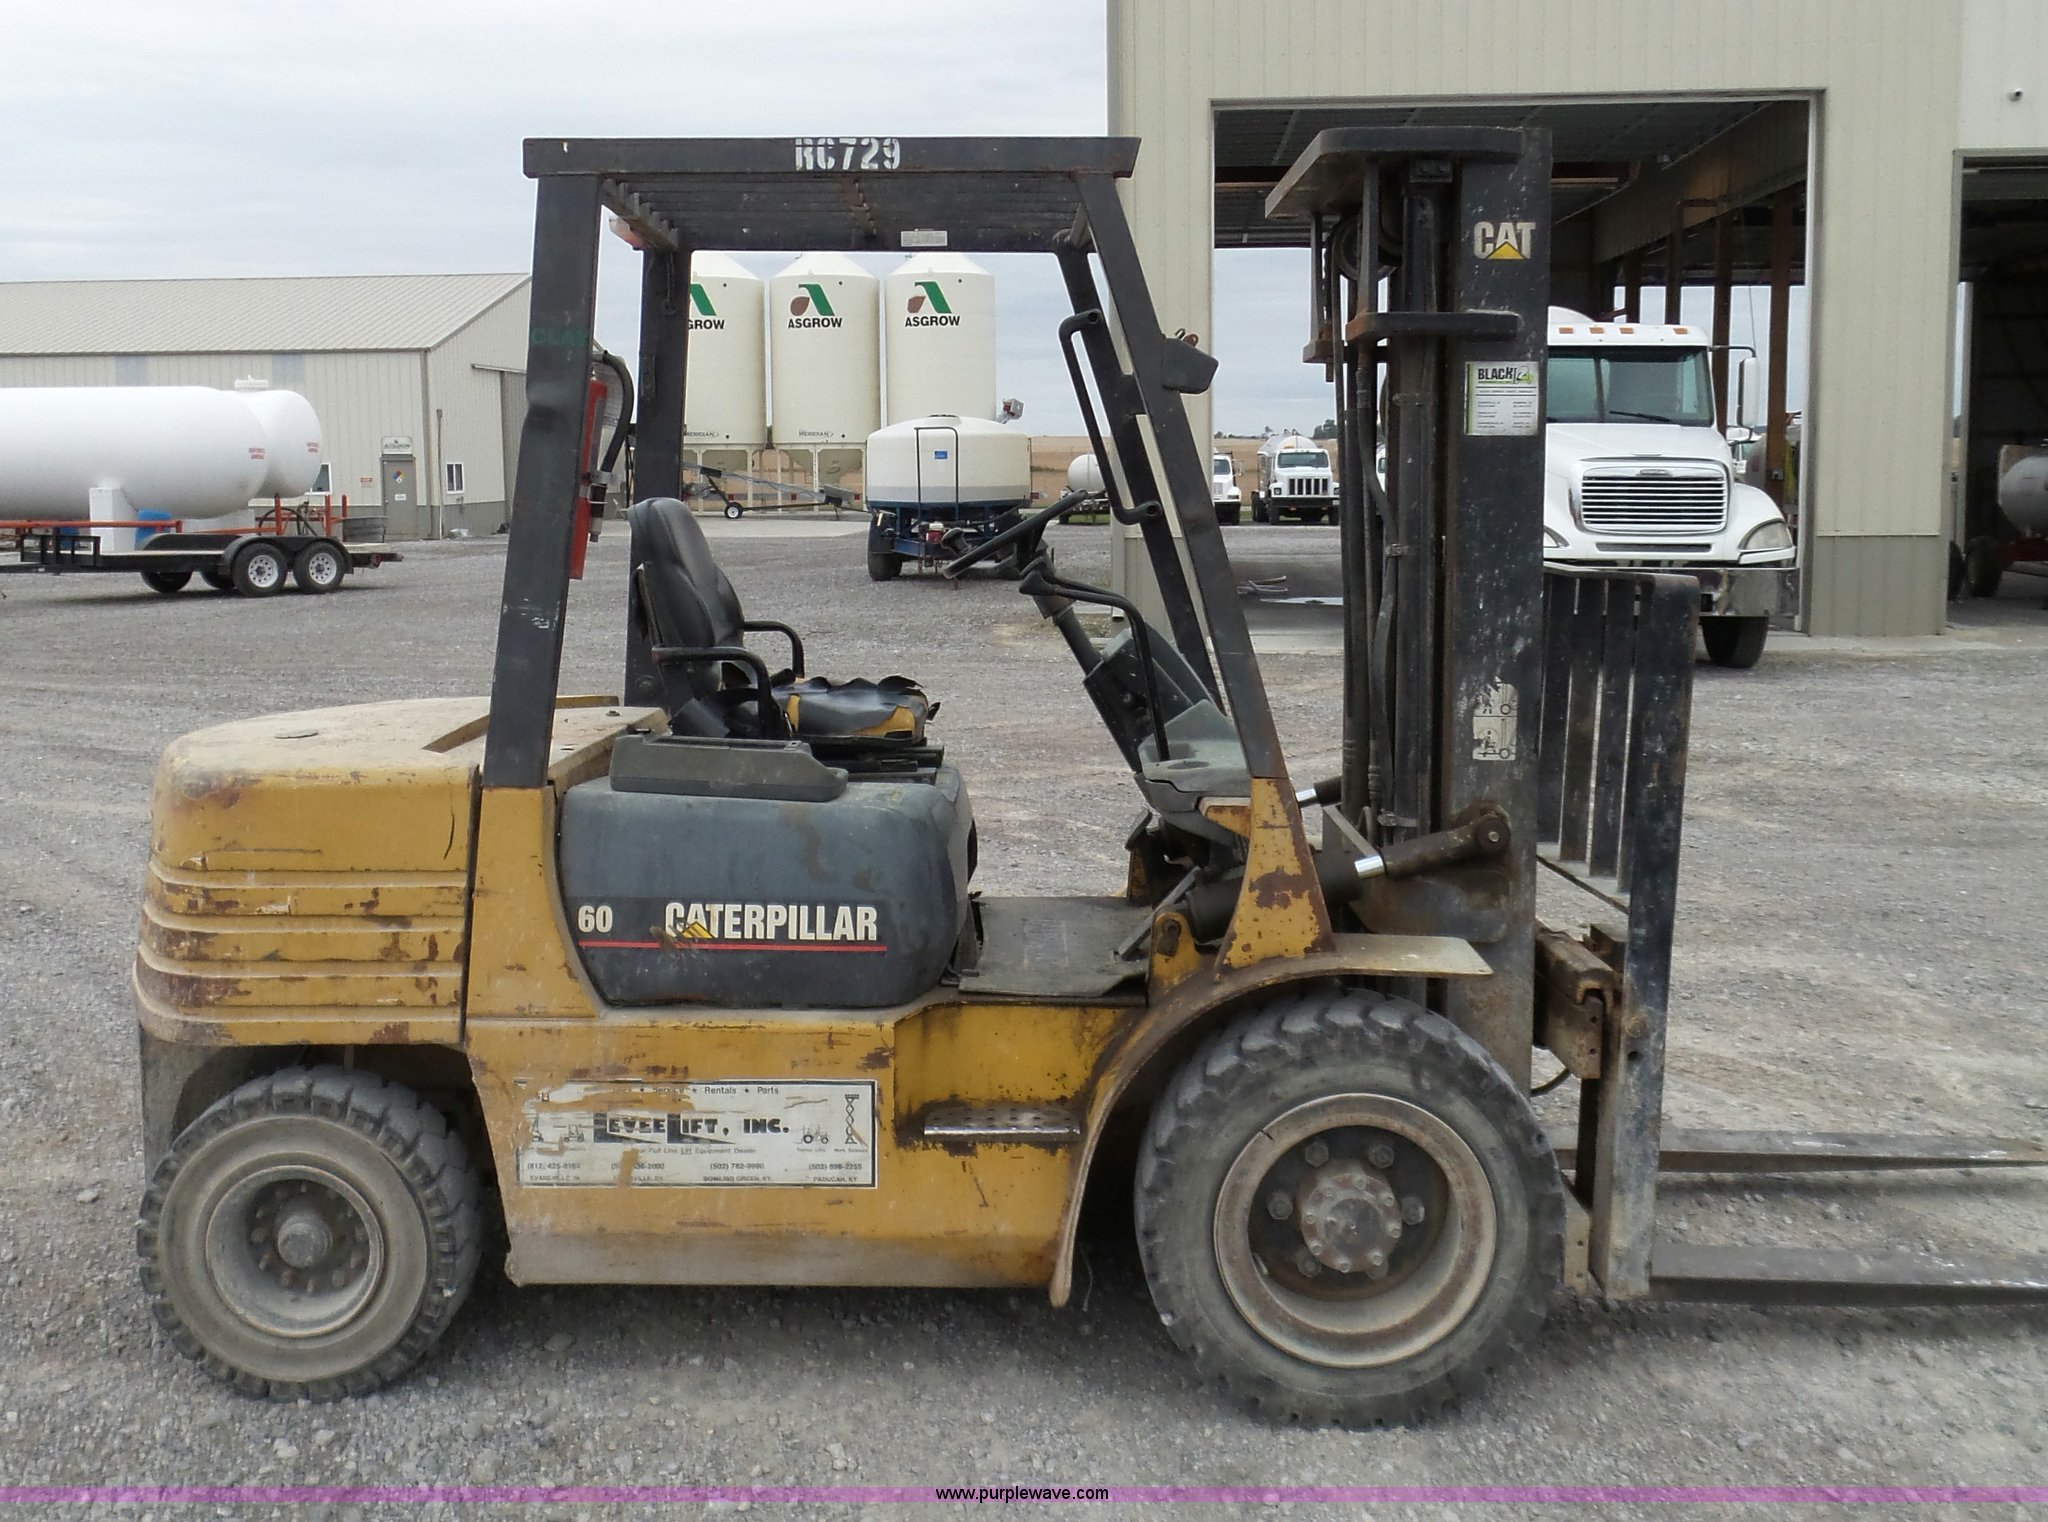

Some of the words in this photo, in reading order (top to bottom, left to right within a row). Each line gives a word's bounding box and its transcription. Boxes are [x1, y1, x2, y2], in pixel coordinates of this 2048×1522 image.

[1473, 221, 1537, 260] CAT
[787, 317, 843, 329] ASGROW
[904, 315, 961, 328] ASGROW
[1477, 366, 1514, 380] BLACK
[577, 905, 613, 933] 60
[665, 902, 878, 941] CATERPILLAR
[704, 1086, 737, 1095] Rentals
[757, 1086, 779, 1095] Parts
[743, 1118, 790, 1134] INC.
